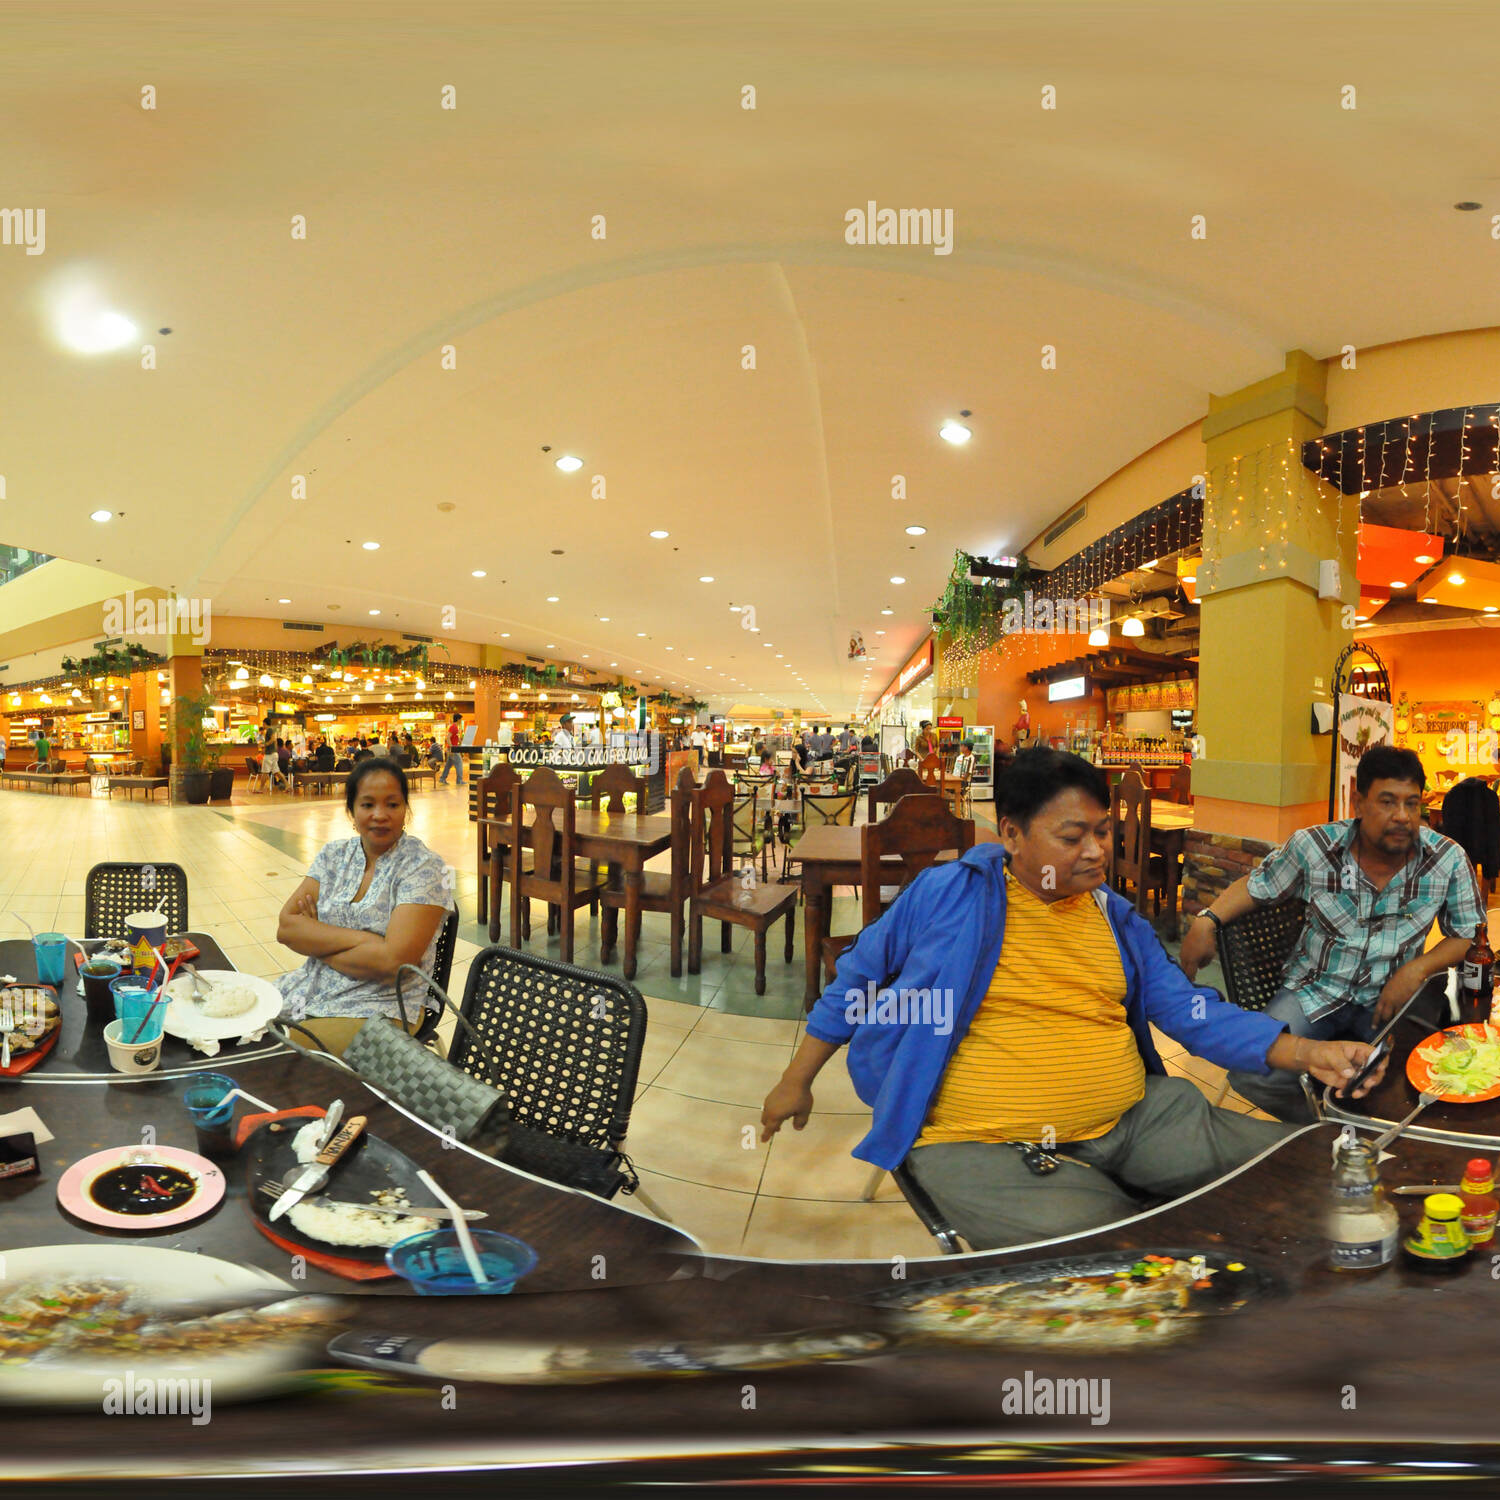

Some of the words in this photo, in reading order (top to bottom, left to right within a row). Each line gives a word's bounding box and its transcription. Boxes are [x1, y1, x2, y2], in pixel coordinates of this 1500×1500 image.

[508, 749, 538, 764] COCO
[542, 749, 585, 766] FRESCO
[588, 748, 608, 765] COCO
